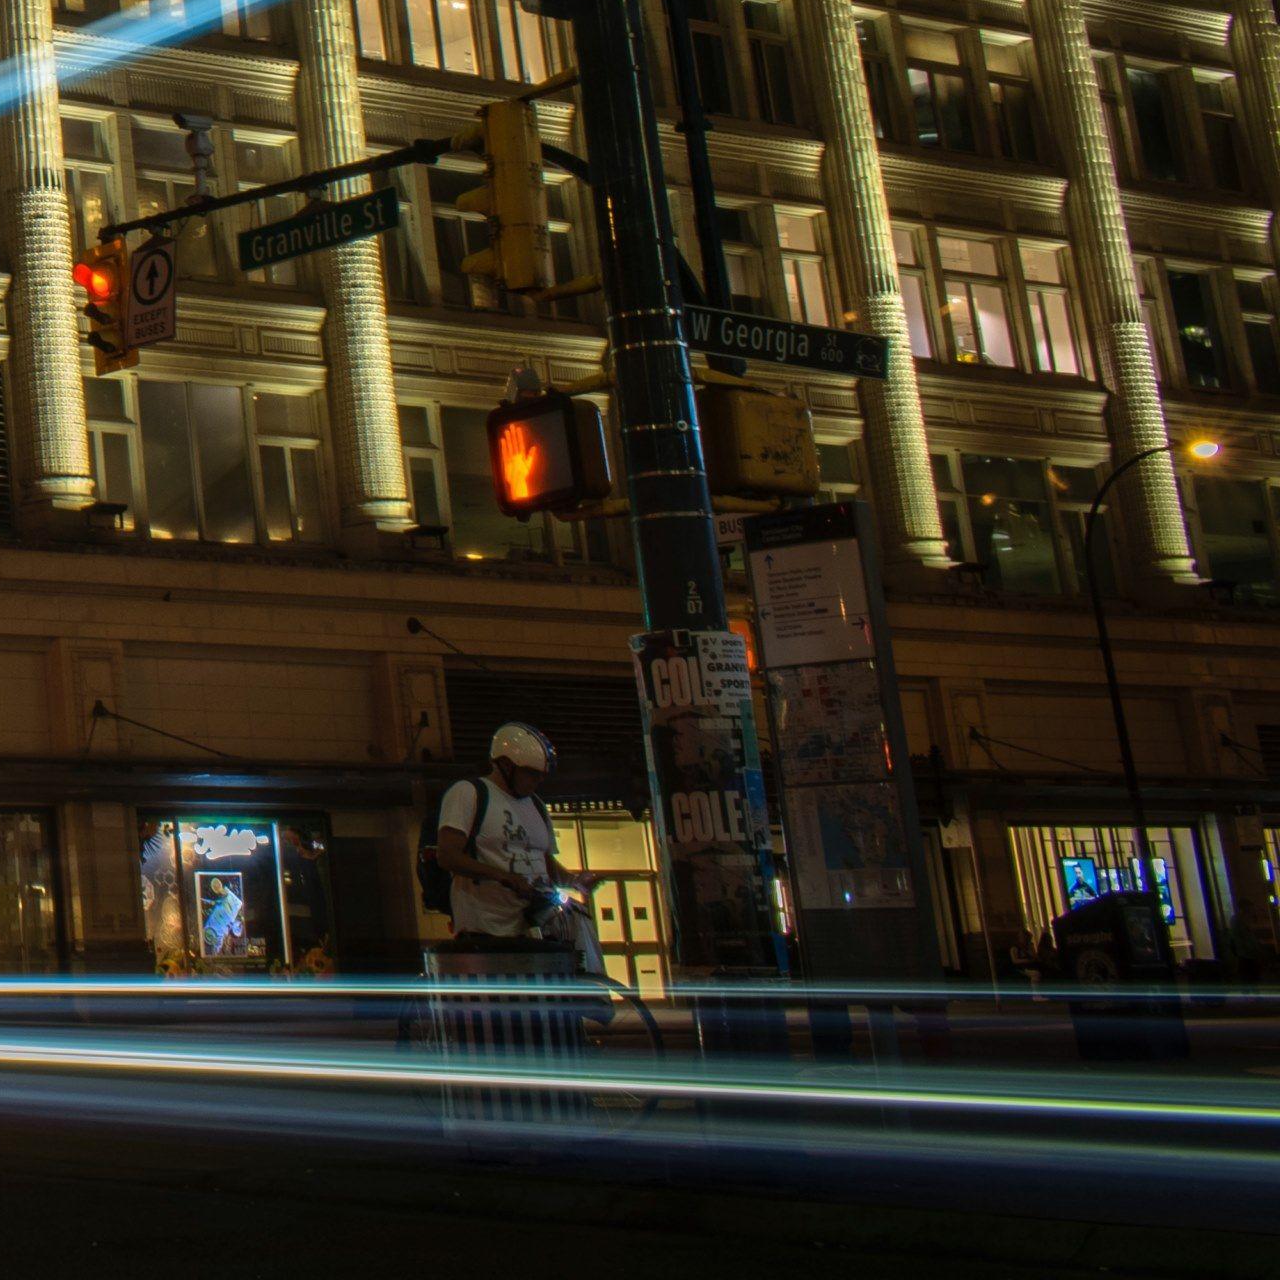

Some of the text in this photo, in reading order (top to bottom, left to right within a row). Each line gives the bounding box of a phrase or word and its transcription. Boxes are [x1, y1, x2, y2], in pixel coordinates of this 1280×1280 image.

[251, 198, 387, 264] Granville St
[133, 306, 168, 325] EXCEPT
[134, 321, 166, 339] BUSES
[691, 311, 838, 362] W Georgia St
[820, 349, 844, 364] 600
